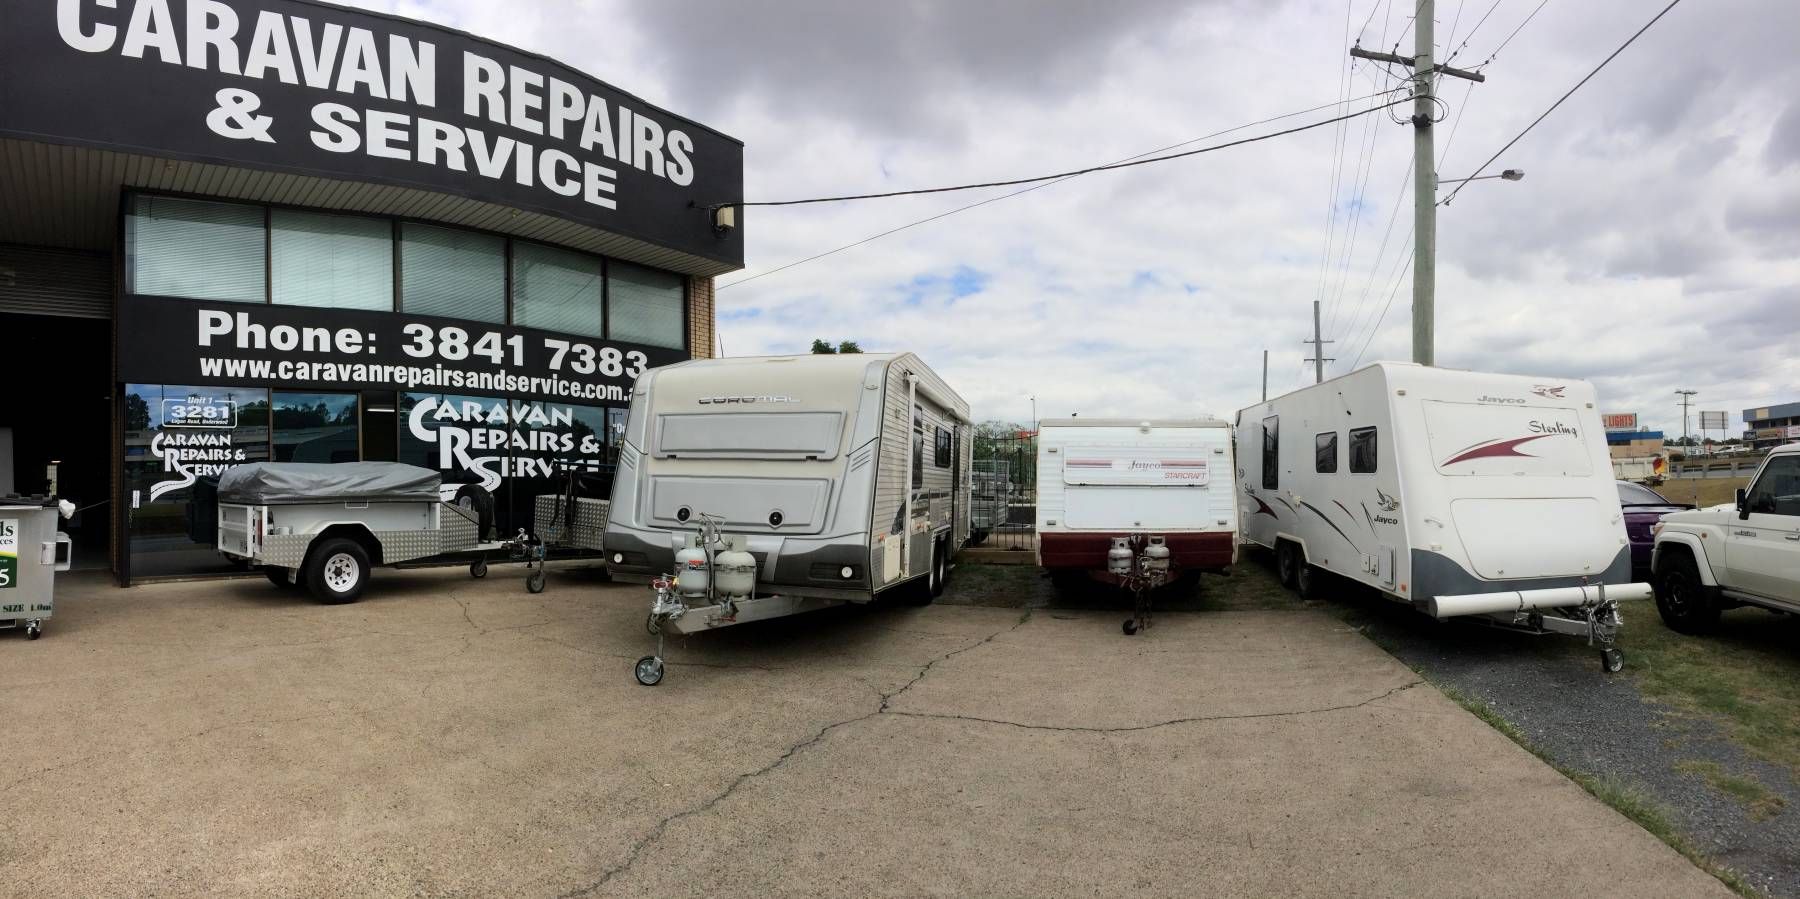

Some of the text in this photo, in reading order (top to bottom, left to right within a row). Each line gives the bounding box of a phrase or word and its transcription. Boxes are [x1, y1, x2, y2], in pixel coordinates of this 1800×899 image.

[56, 0, 695, 187] CARAVAN REPAIRS
[205, 87, 618, 210] & SERVICE
[198, 309, 648, 379] Phone: 3841 7383
[187, 397, 206, 405] Unit
[1477, 395, 1526, 404] Jayco
[171, 405, 229, 418] 3281
[409, 396, 573, 442] CARAVAN
[1528, 420, 1577, 438] Sterling
[1608, 415, 1633, 427] LIGHTS
[151, 432, 231, 458] CARAVAN
[439, 426, 600, 471] REPAIRS &
[164, 448, 246, 472] REPAIRS &
[1128, 460, 1161, 471] Jayco
[1164, 472, 1207, 480] STARCRAFT
[1374, 514, 1398, 525] Jayco
